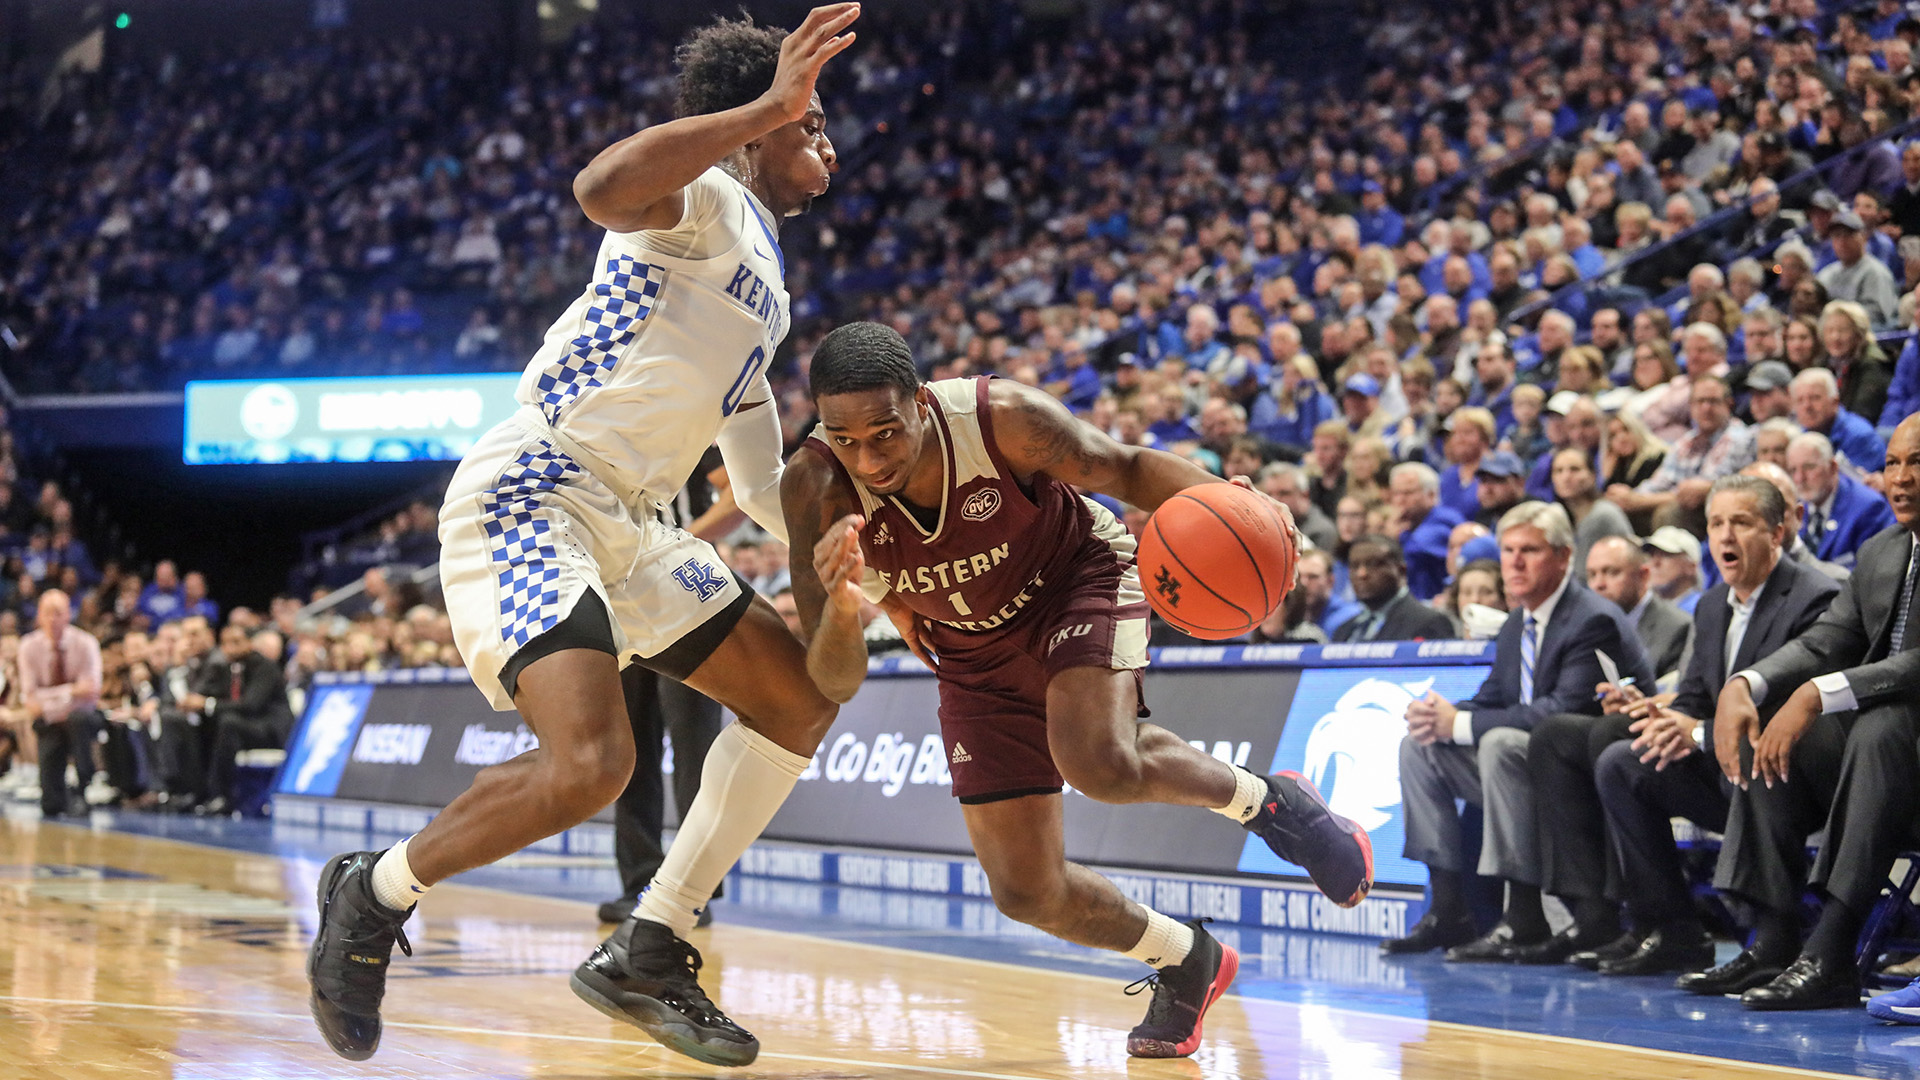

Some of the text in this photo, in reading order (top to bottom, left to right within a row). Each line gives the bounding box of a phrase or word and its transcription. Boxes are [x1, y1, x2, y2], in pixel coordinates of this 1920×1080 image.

[722, 345, 765, 417] 0
[969, 494, 992, 514] OVC
[671, 557, 728, 603] UK
[878, 542, 1010, 594] EASTERN
[948, 591, 973, 616] 1
[1048, 624, 1093, 658] EKU
[825, 732, 867, 782] Go
[863, 732, 916, 797] Big
[1261, 889, 1286, 926] BIG
[1288, 892, 1309, 929] ON
